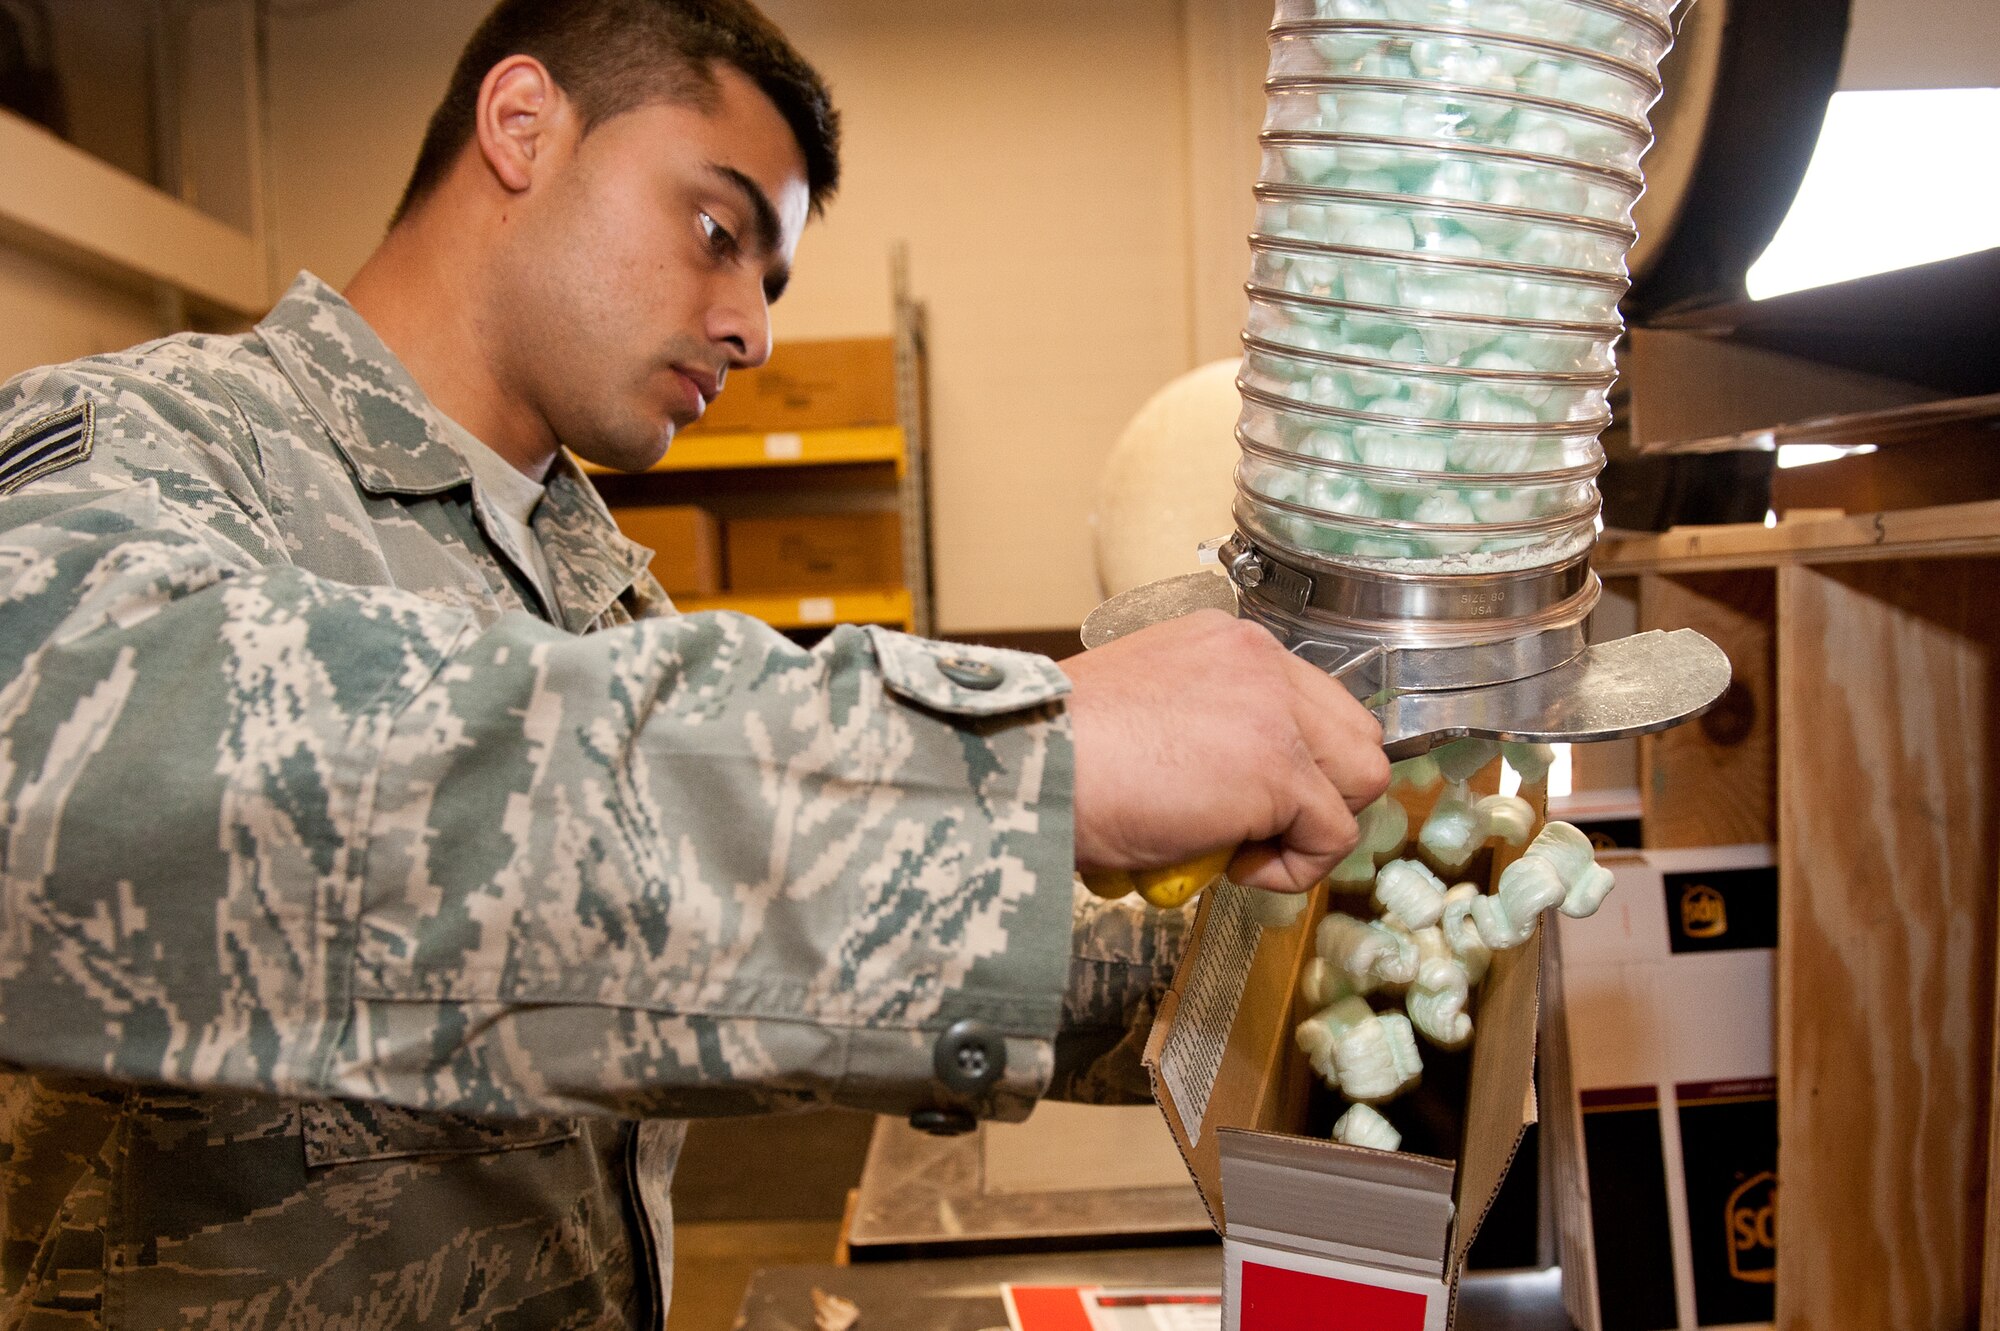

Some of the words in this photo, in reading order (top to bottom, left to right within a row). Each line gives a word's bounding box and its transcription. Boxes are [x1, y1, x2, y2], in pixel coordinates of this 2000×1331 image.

[1460, 593, 1486, 604] SIZE
[1490, 591, 1505, 602] 80
[1470, 605, 1492, 616] USA
